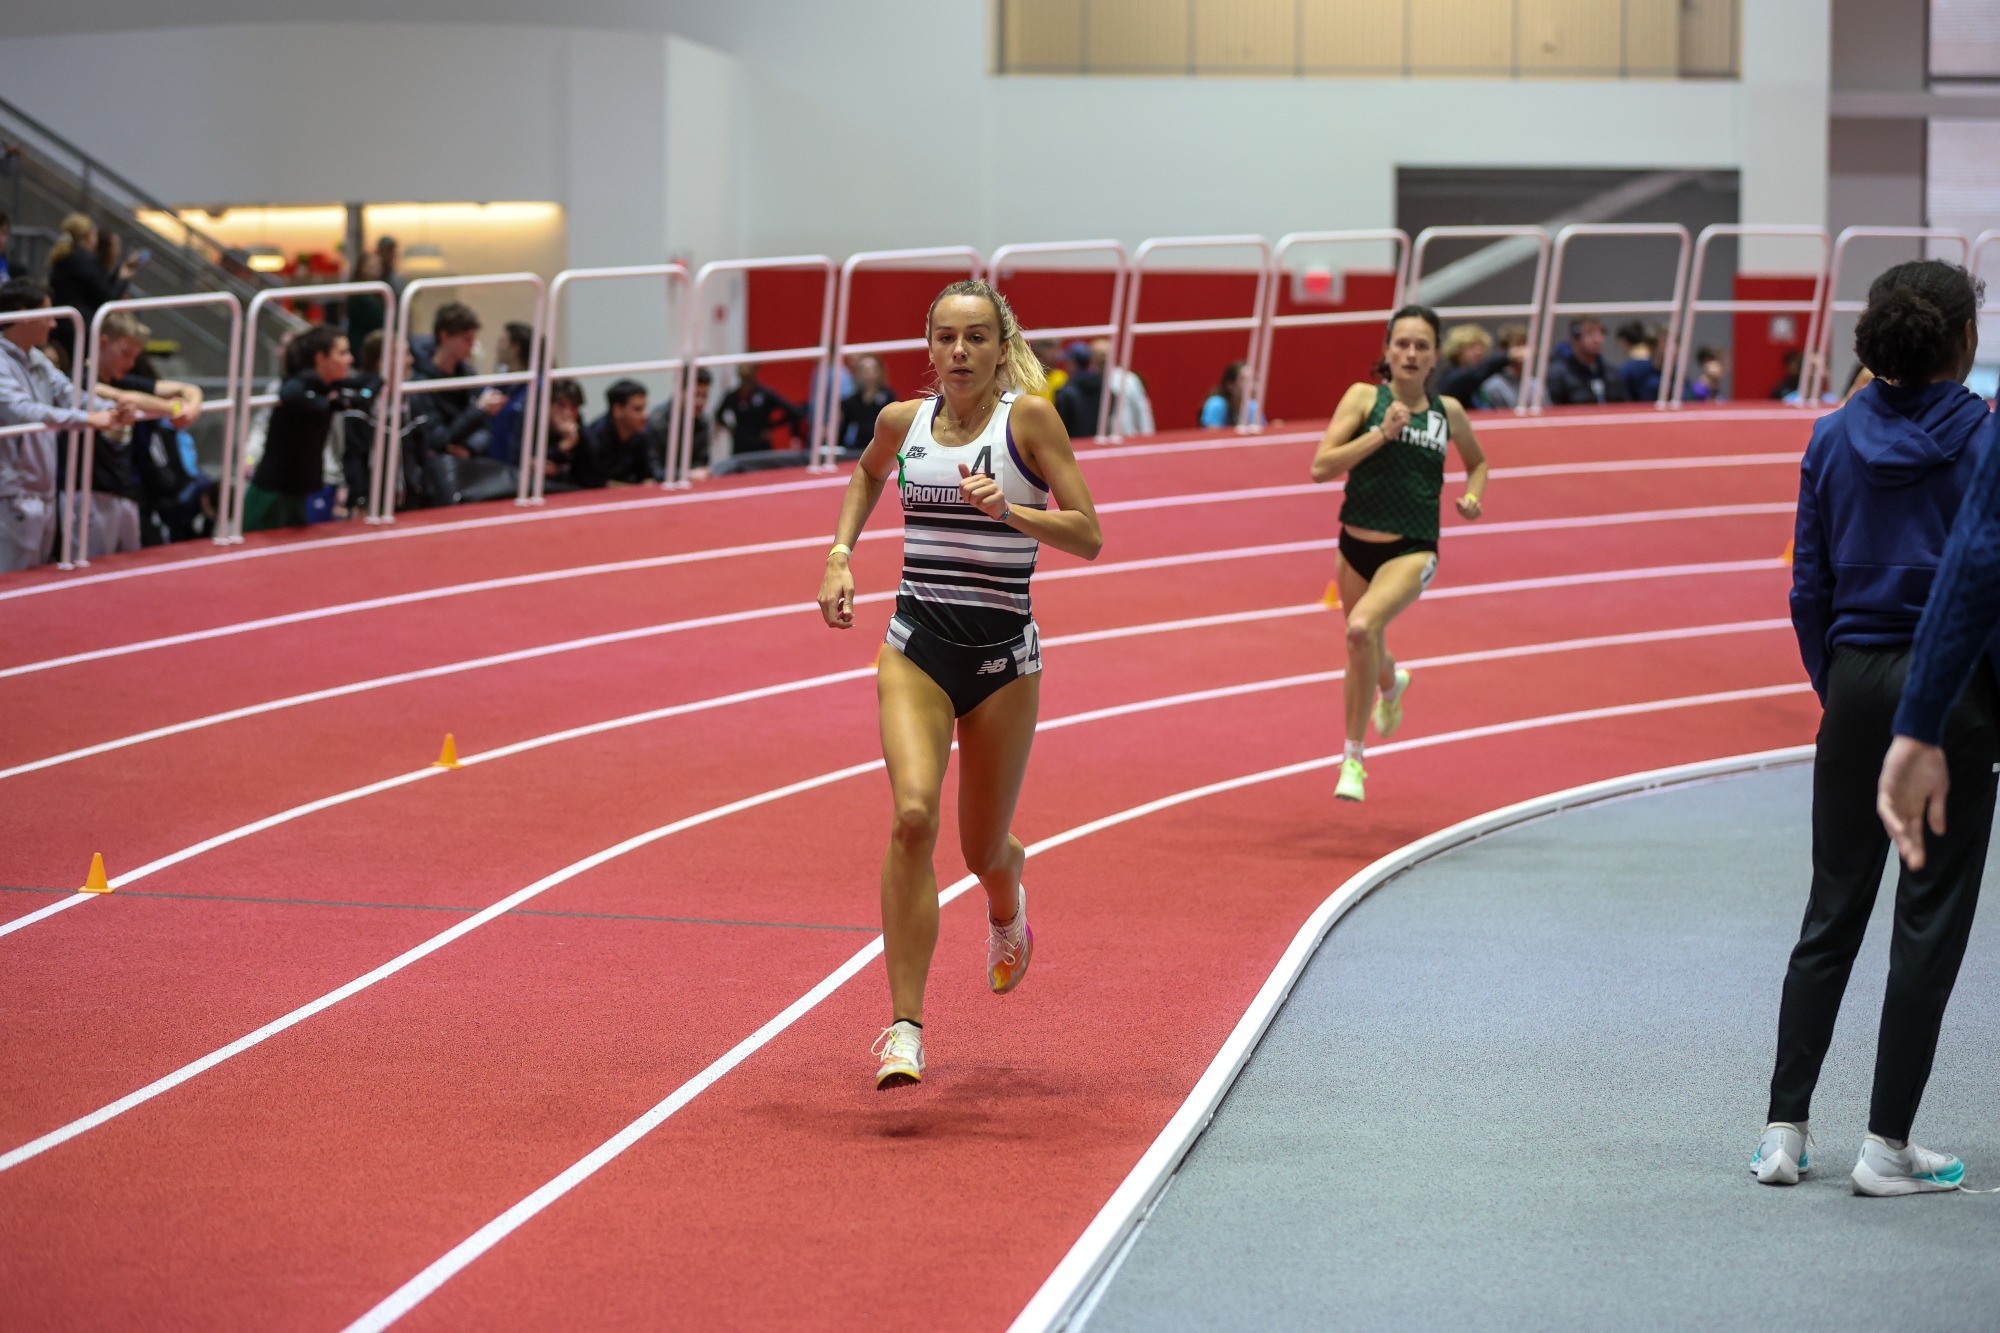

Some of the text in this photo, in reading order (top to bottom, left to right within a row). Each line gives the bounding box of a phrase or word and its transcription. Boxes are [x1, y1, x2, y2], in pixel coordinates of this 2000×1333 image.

[1433, 414, 1444, 438] 7
[970, 445, 996, 480] 4
[1028, 625, 1040, 668] 4
